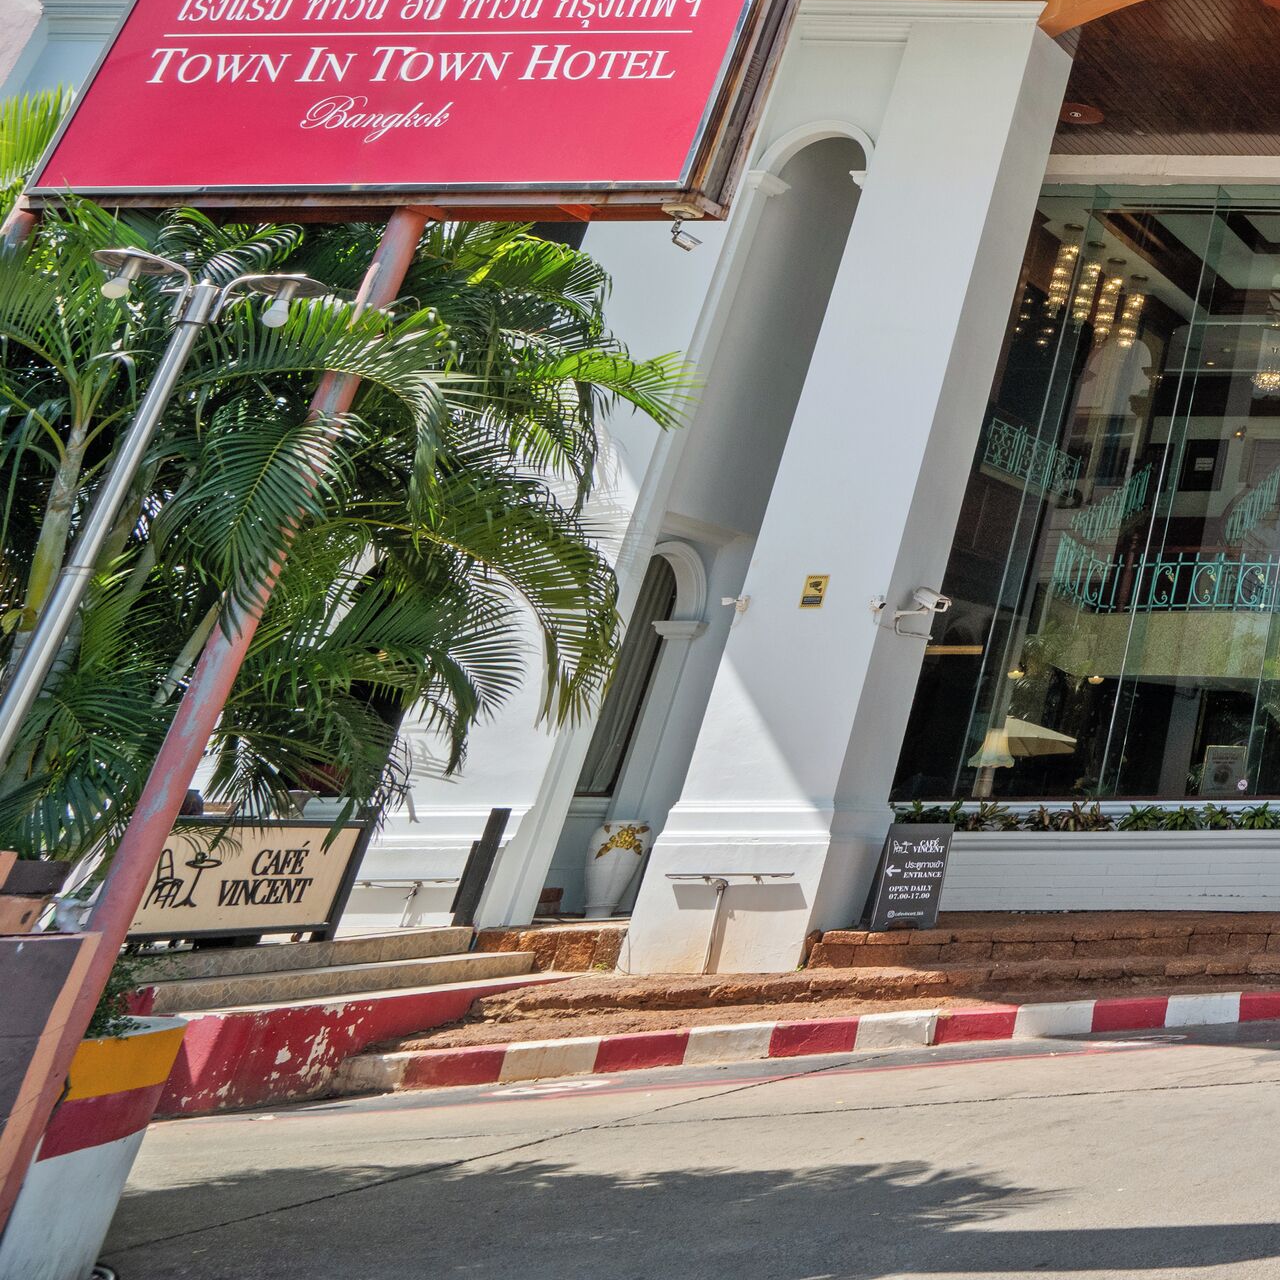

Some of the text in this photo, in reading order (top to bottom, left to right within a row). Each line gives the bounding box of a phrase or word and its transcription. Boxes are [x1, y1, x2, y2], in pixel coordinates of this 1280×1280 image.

[146, 44, 676, 85] TOWN IN TOWN HOTEL
[300, 95, 454, 144] Bangkok
[913, 845, 945, 853] VINCENT
[920, 837, 940, 847] CAFÉ
[250, 840, 310, 876] CAFÉ
[903, 871, 942, 879] ENTRANCE
[217, 878, 313, 907] VINCENT
[910, 884, 932, 892] DAILY
